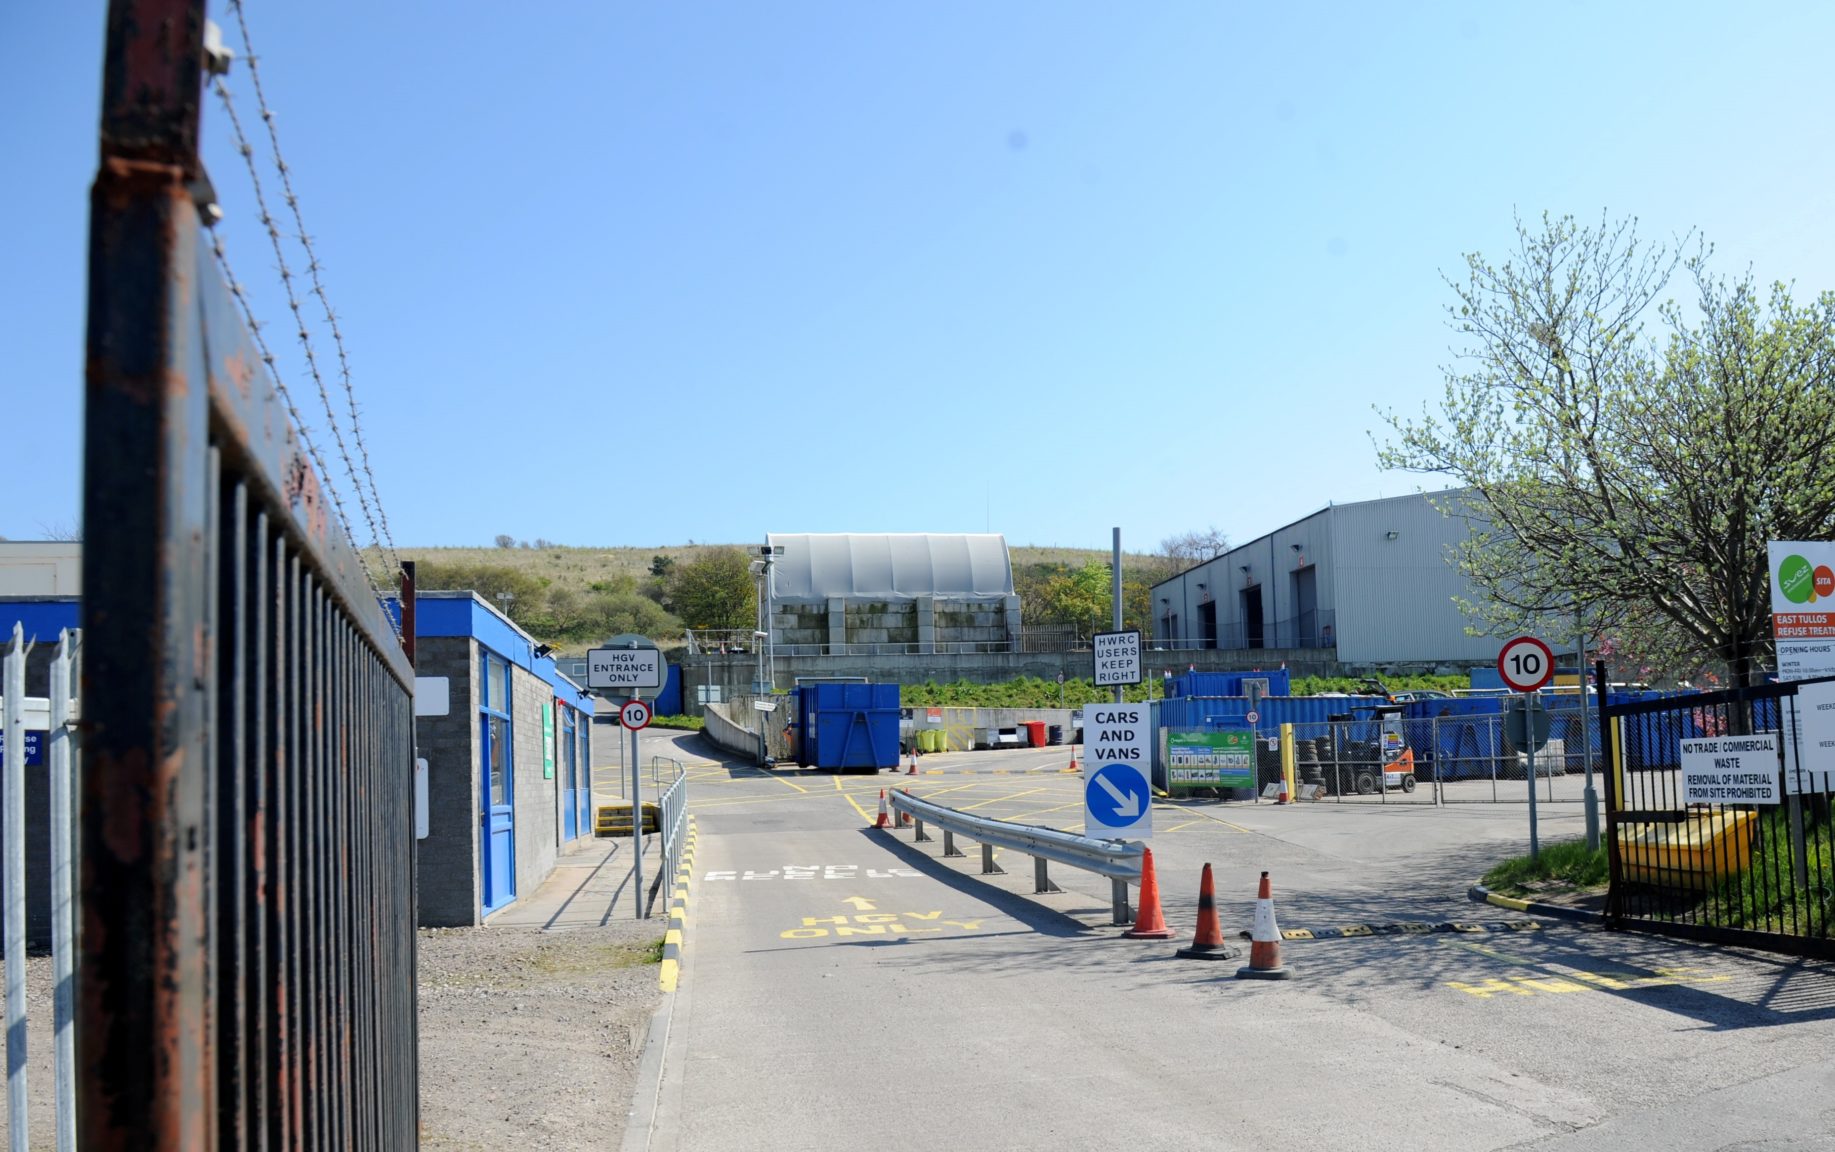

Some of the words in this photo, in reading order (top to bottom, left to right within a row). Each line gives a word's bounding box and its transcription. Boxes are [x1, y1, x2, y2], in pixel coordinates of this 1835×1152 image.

[1816, 577, 1831, 585] SITA
[1776, 615, 1797, 624] EAST
[1798, 614, 1828, 624] TULLOS
[1777, 626, 1808, 636] REFUSE
[1098, 635, 1135, 646] HWRC
[1097, 647, 1137, 659] USERS
[1780, 646, 1809, 654] OPENING
[1809, 645, 1831, 653] HOURS
[612, 653, 636, 662] HGV
[593, 663, 654, 673] ENTRANCE
[1101, 659, 1133, 670] KEEP
[1510, 653, 1541, 675] 10
[609, 673, 639, 682] ONLY
[1099, 670, 1136, 682] RIGHT
[627, 709, 644, 722] 10
[1095, 711, 1139, 725] CARS
[1099, 729, 1135, 742] AND
[1682, 743, 1693, 754] NO
[1694, 742, 1718, 753] TRADE
[1723, 739, 1774, 752] COMMERCIAL
[1095, 747, 1140, 760] VANS
[1714, 757, 1740, 769] WASTE
[1687, 774, 1721, 785] REMOVAL
[1722, 774, 1732, 785] OF
[1733, 773, 1772, 785] MATERIAL
[1688, 787, 1709, 798] FROM
[1709, 787, 1726, 798] SITE
[1727, 787, 1772, 799] PROHIBITED
[800, 910, 943, 926] HGV
[779, 919, 985, 939] ONLY
